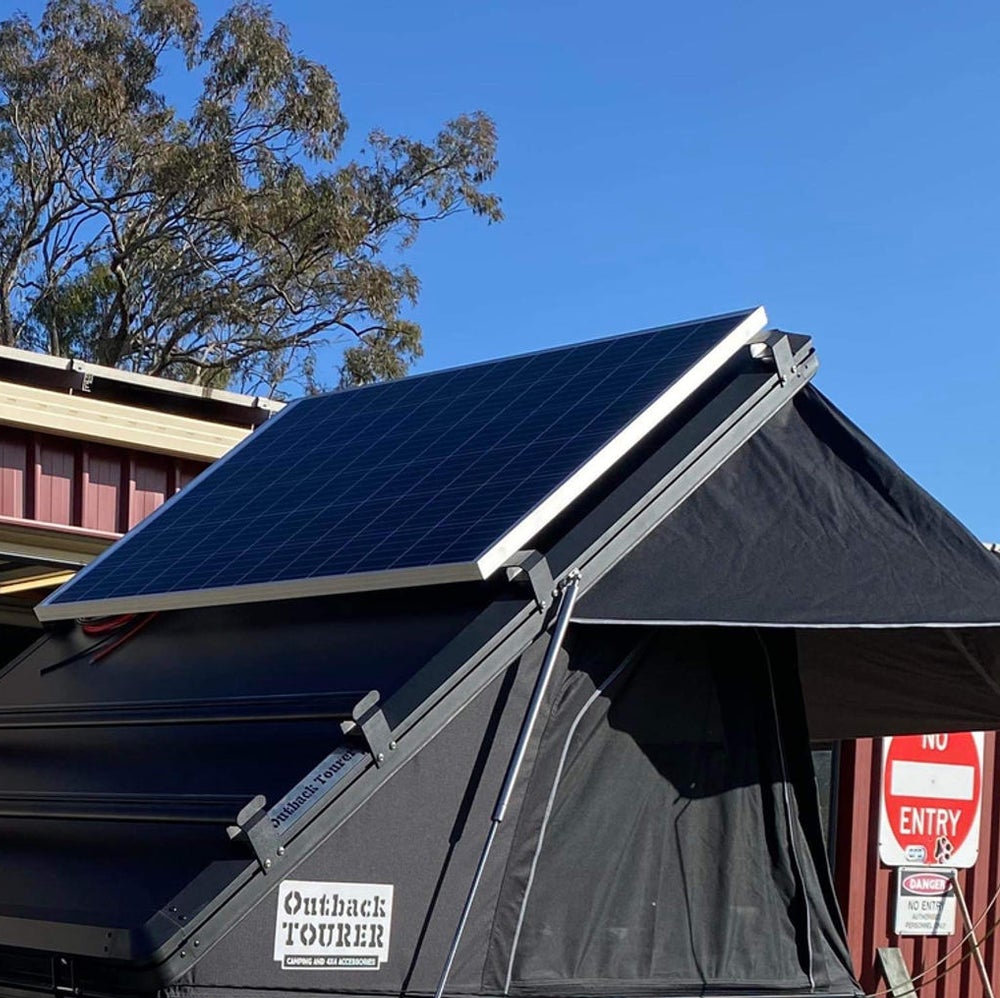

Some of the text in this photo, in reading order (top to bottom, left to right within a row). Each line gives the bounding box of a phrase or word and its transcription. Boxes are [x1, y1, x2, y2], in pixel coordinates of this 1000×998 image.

[922, 734, 948, 751] NO
[900, 806, 962, 837] ENTRY
[909, 878, 946, 890] DANGER
[284, 890, 386, 918] Outback
[908, 900, 919, 911] NO
[282, 922, 384, 948] TOURER
[286, 957, 313, 966] CAMPING
[313, 957, 326, 966] AND
[338, 957, 376, 966] ACCESSORIES
